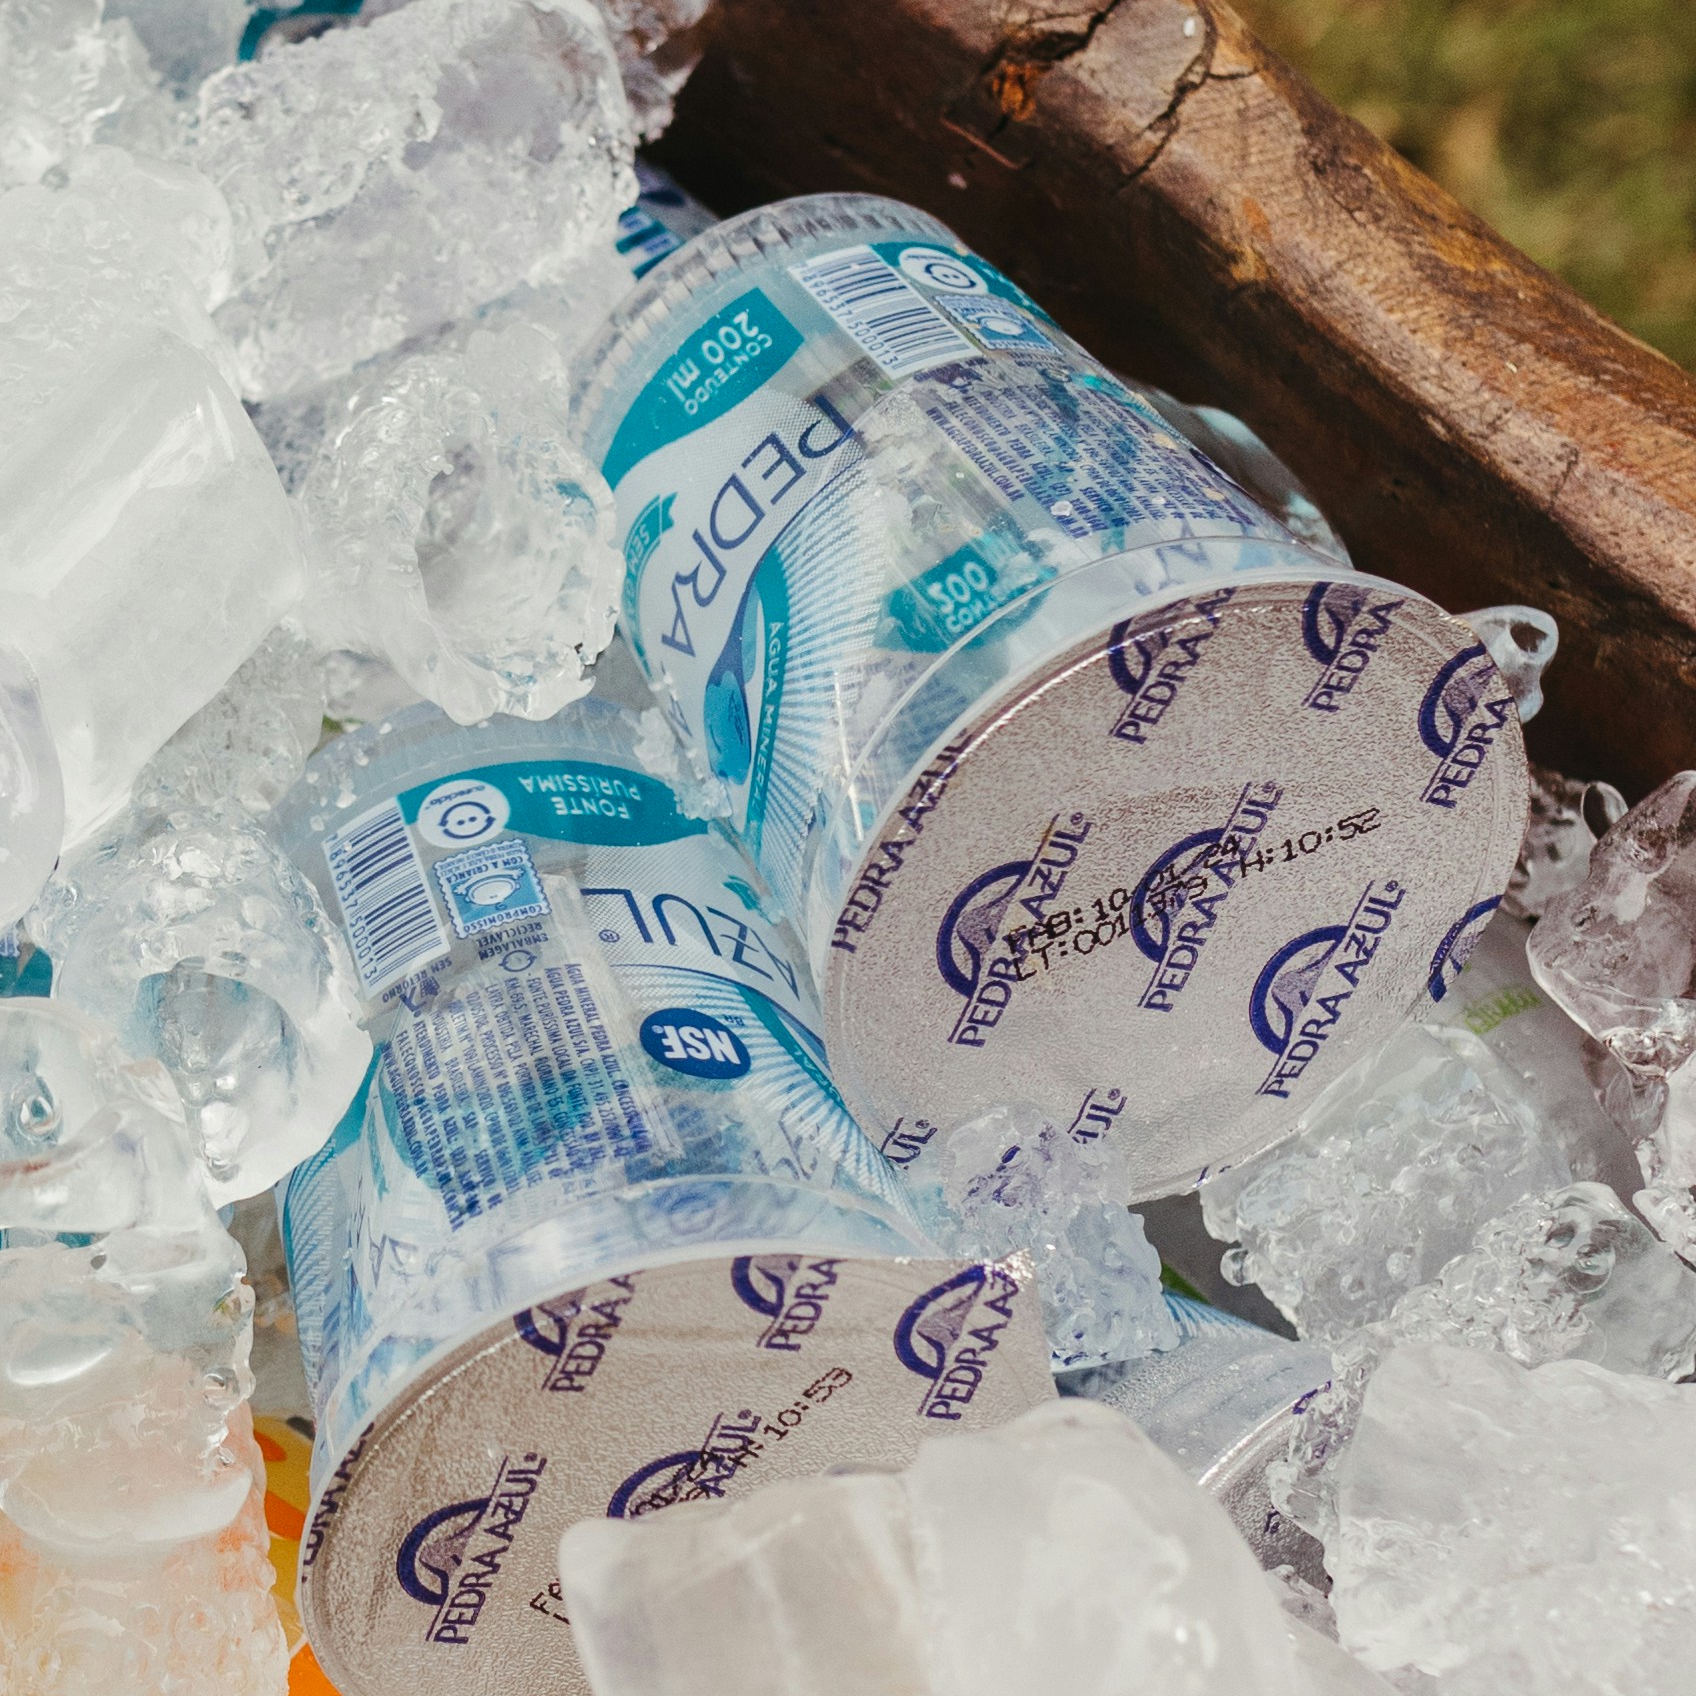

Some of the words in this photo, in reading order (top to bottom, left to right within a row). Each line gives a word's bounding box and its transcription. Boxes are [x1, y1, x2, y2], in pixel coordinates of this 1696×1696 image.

[696, 309, 762, 367] 200
[664, 357, 706, 401] ml
[681, 331, 775, 417] CONTEÚDO
[661, 391, 860, 657] PEDRA
[1309, 597, 1398, 711] PEDRA
[1110, 625, 1210, 742] PEDRA
[1426, 695, 1515, 808] PEDRA
[518, 774, 643, 802] PURÍSSIMA
[552, 796, 632, 820] FONTE
[445, 861, 492, 885] CRIANÇA
[494, 859, 505, 870] A
[506, 855, 525, 867] COM
[1019, 817, 1087, 918] AZUL
[323, 848, 362, 911] 896537
[345, 915, 382, 979] 500013
[461, 905, 544, 934] COMPROMISSO
[1144, 883, 1226, 1012] PEDRA
[1210, 786, 1278, 888] AZUL
[476, 921, 543, 947] RECICLÁVEL
[477, 932, 548, 961] EMBALAGEM
[580, 888, 801, 1002] AZUL
[428, 960, 454, 981] SEM
[524, 975, 548, 1003] FONTE
[542, 963, 566, 990] ÁGUA
[563, 959, 587, 986] ÁGUA
[1259, 977, 1342, 1097] PEDRA
[1332, 883, 1392, 987] AZUL
[483, 982, 507, 1011] LAVRA
[552, 987, 577, 1018] PEDRA
[573, 983, 600, 1024] MINERAL
[493, 1009, 517, 1041] OBTIDA
[517, 1012, 544, 1057] MARECHAL
[535, 1000, 565, 1045] PURÍSSIMA
[562, 1015, 584, 1040] AZUL
[588, 1021, 613, 1054] PEDRA
[723, 1014, 745, 1027] BR
[478, 1028, 504, 1071] PROCESSO
[550, 1043, 572, 1070] LOCAL
[661, 1024, 742, 1065] NSF
[409, 1019, 443, 1081] ATENDIMENTO
[429, 1082, 453, 1115] PEDRA
[460, 1110, 480, 1131] SAP
[553, 1292, 616, 1393] PEDRA
[924, 1308, 997, 1420] PEDRA
[726, 1361, 856, 1473] H:10:53
[431, 1538, 510, 1644] PEDRA
[487, 1459, 546, 1539] AZUL
